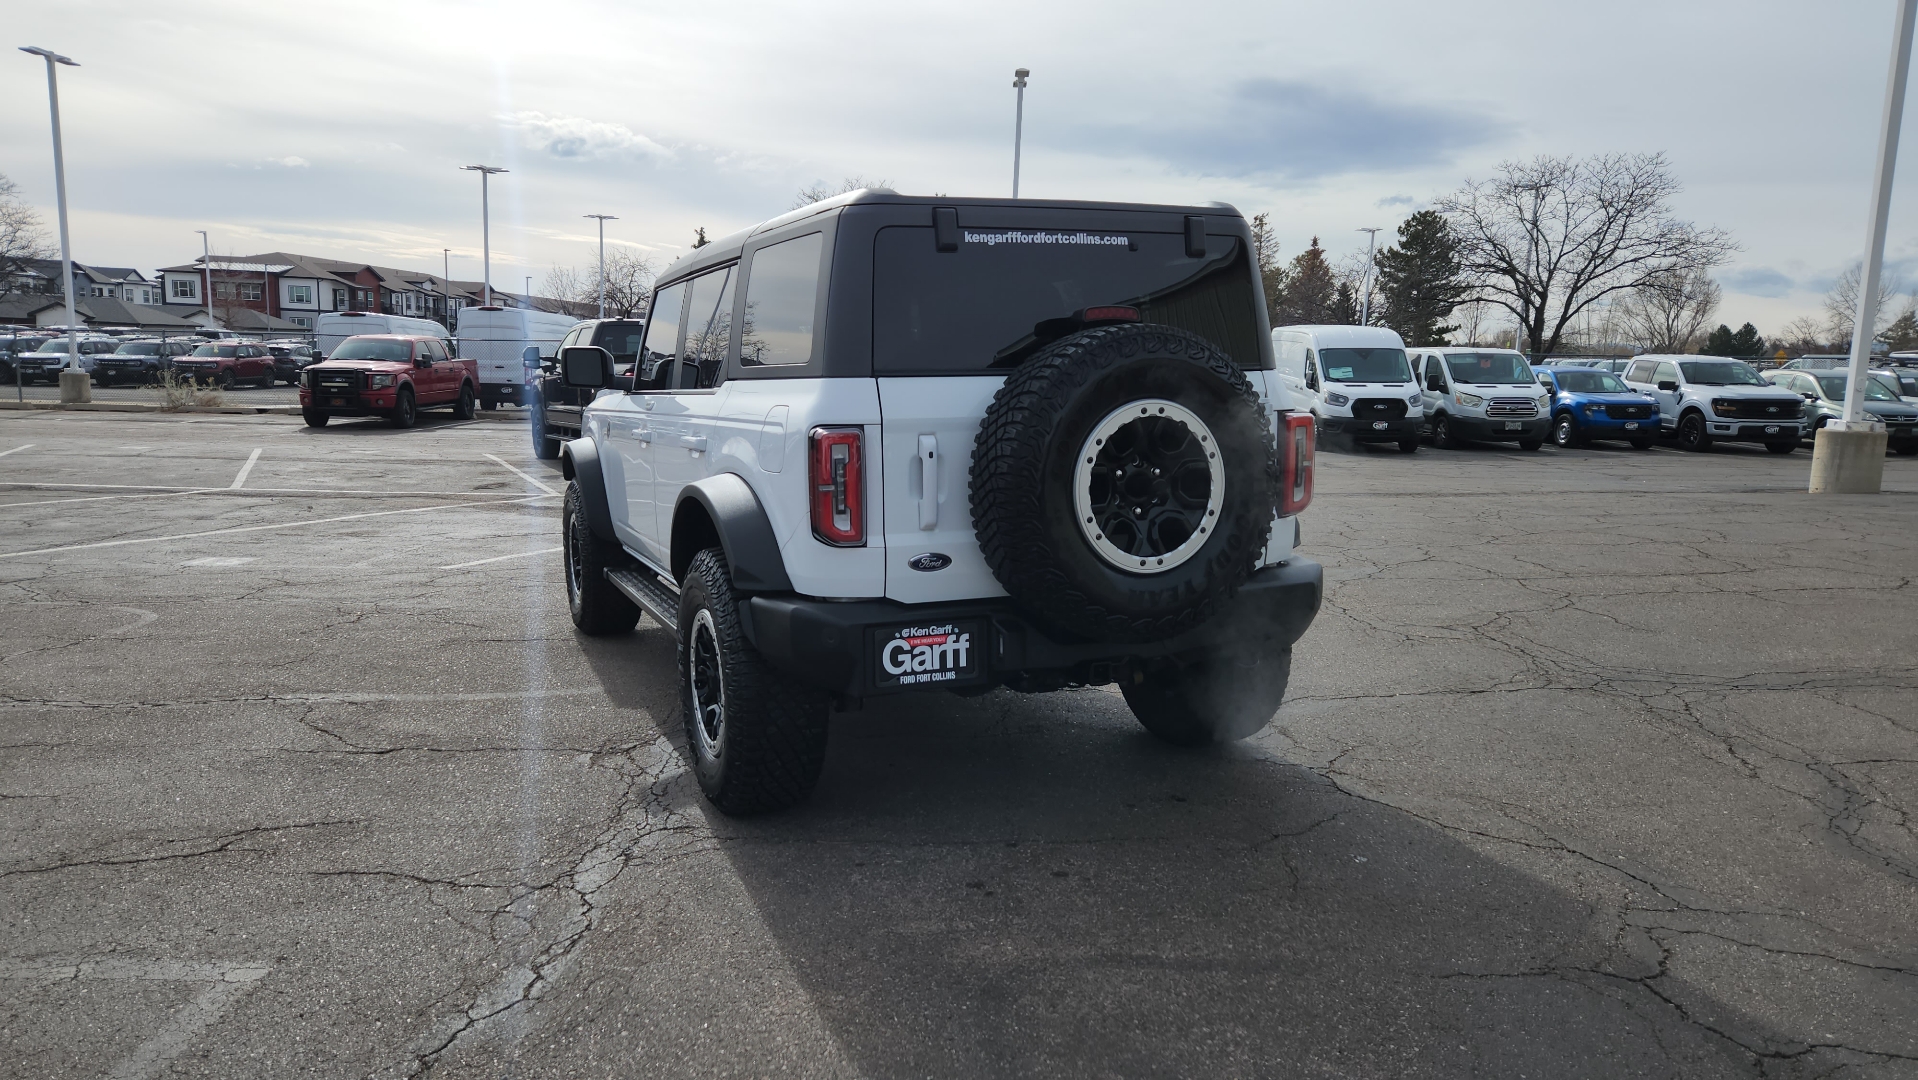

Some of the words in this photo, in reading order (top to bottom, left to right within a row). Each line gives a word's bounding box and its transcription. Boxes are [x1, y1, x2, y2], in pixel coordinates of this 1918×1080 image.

[919, 557, 942, 568] Ford
[911, 627, 928, 636] Ken
[929, 624, 952, 635] Garff
[882, 633, 970, 675] Garff
[900, 674, 915, 684] FORD
[917, 673, 931, 682] FORT
[932, 671, 956, 681] COLLINS
